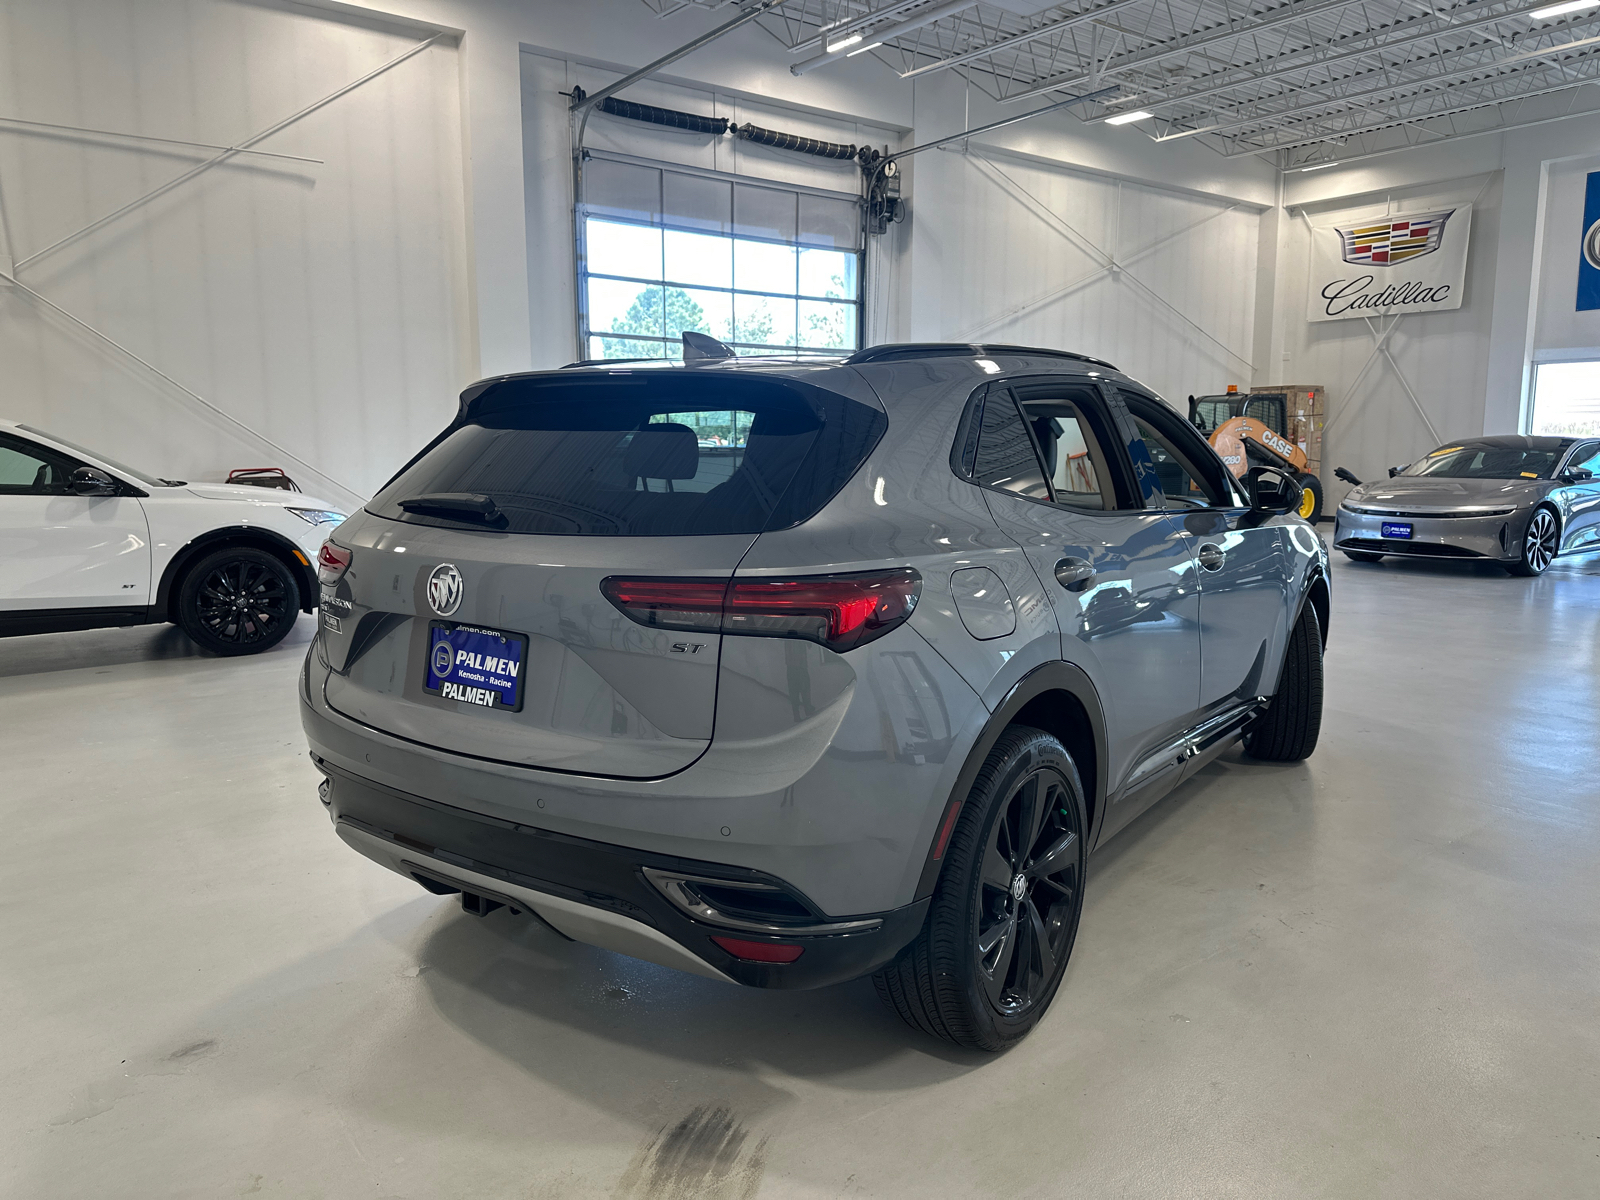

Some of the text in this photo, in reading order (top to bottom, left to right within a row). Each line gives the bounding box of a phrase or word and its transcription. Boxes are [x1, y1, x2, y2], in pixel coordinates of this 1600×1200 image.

[1321, 275, 1451, 316] Cadillac
[1262, 430, 1293, 458] CASE
[669, 643, 707, 654] ST
[455, 649, 520, 677] PALMEN
[458, 669, 485, 682] Kenosha
[489, 676, 512, 689] Racine
[442, 682, 495, 707] PALMEN
